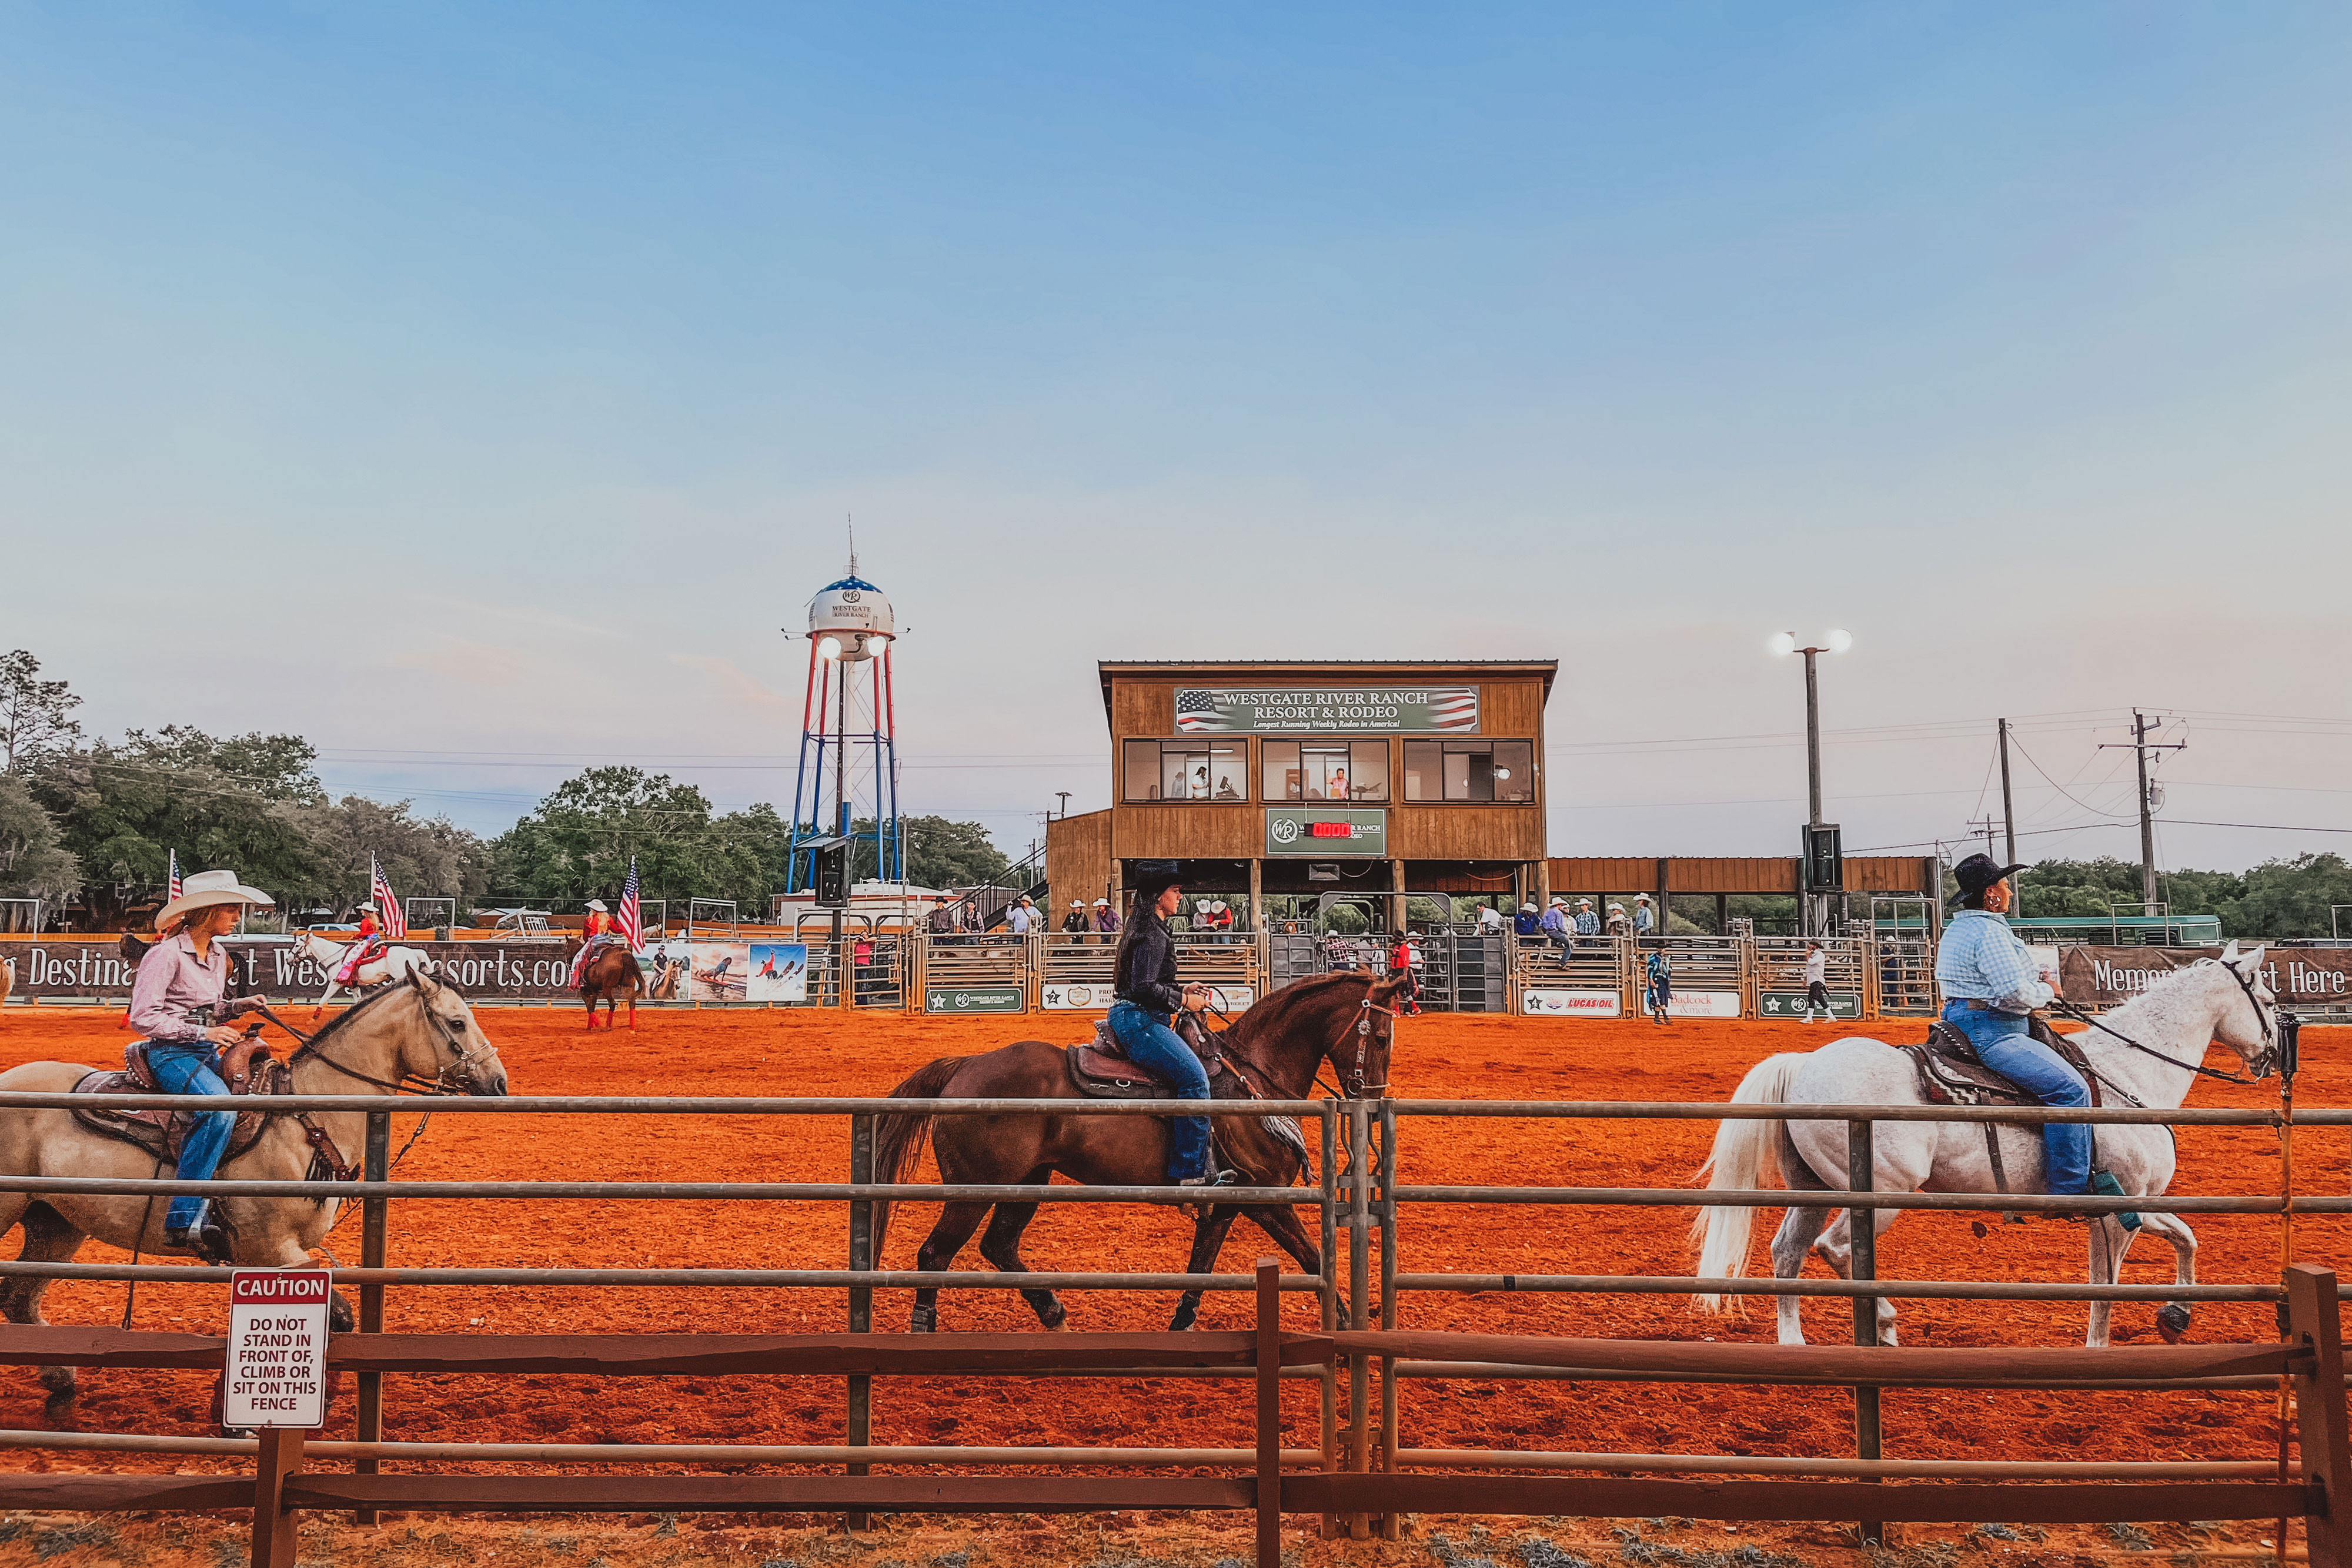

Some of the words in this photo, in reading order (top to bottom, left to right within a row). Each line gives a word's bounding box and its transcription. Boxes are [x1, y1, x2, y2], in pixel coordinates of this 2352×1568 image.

[1223, 693, 1312, 705] WESTGATE
[1315, 693, 1366, 705] RIVER
[1369, 693, 1428, 704] RANCH
[1254, 707, 1319, 718] RESORT
[1322, 707, 1335, 718] &
[1338, 706, 1398, 718] RODEO
[1253, 720, 1280, 730] Longest
[1281, 720, 1311, 730] Running
[1312, 720, 1337, 730] Weekly
[28, 948, 133, 987] Destina
[2289, 962, 2346, 994] Here
[1531, 999, 1538, 1007] 4
[1568, 998, 1598, 1008] LUCAS
[1598, 998, 1614, 1008] OIL
[1671, 994, 1712, 1004] Badcock
[237, 1279, 325, 1296] CAUTION
[250, 1319, 272, 1330] DO
[276, 1319, 307, 1330] NOT
[243, 1334, 292, 1346] STAND
[296, 1334, 310, 1346] IN
[239, 1350, 288, 1362] FRONT
[292, 1350, 313, 1364] OF,
[240, 1366, 286, 1378] CLIMB
[289, 1366, 310, 1378] OR
[233, 1382, 255, 1394] SIT
[258, 1382, 280, 1394] ON
[283, 1382, 316, 1394] THIS
[251, 1398, 297, 1410] FENCE
